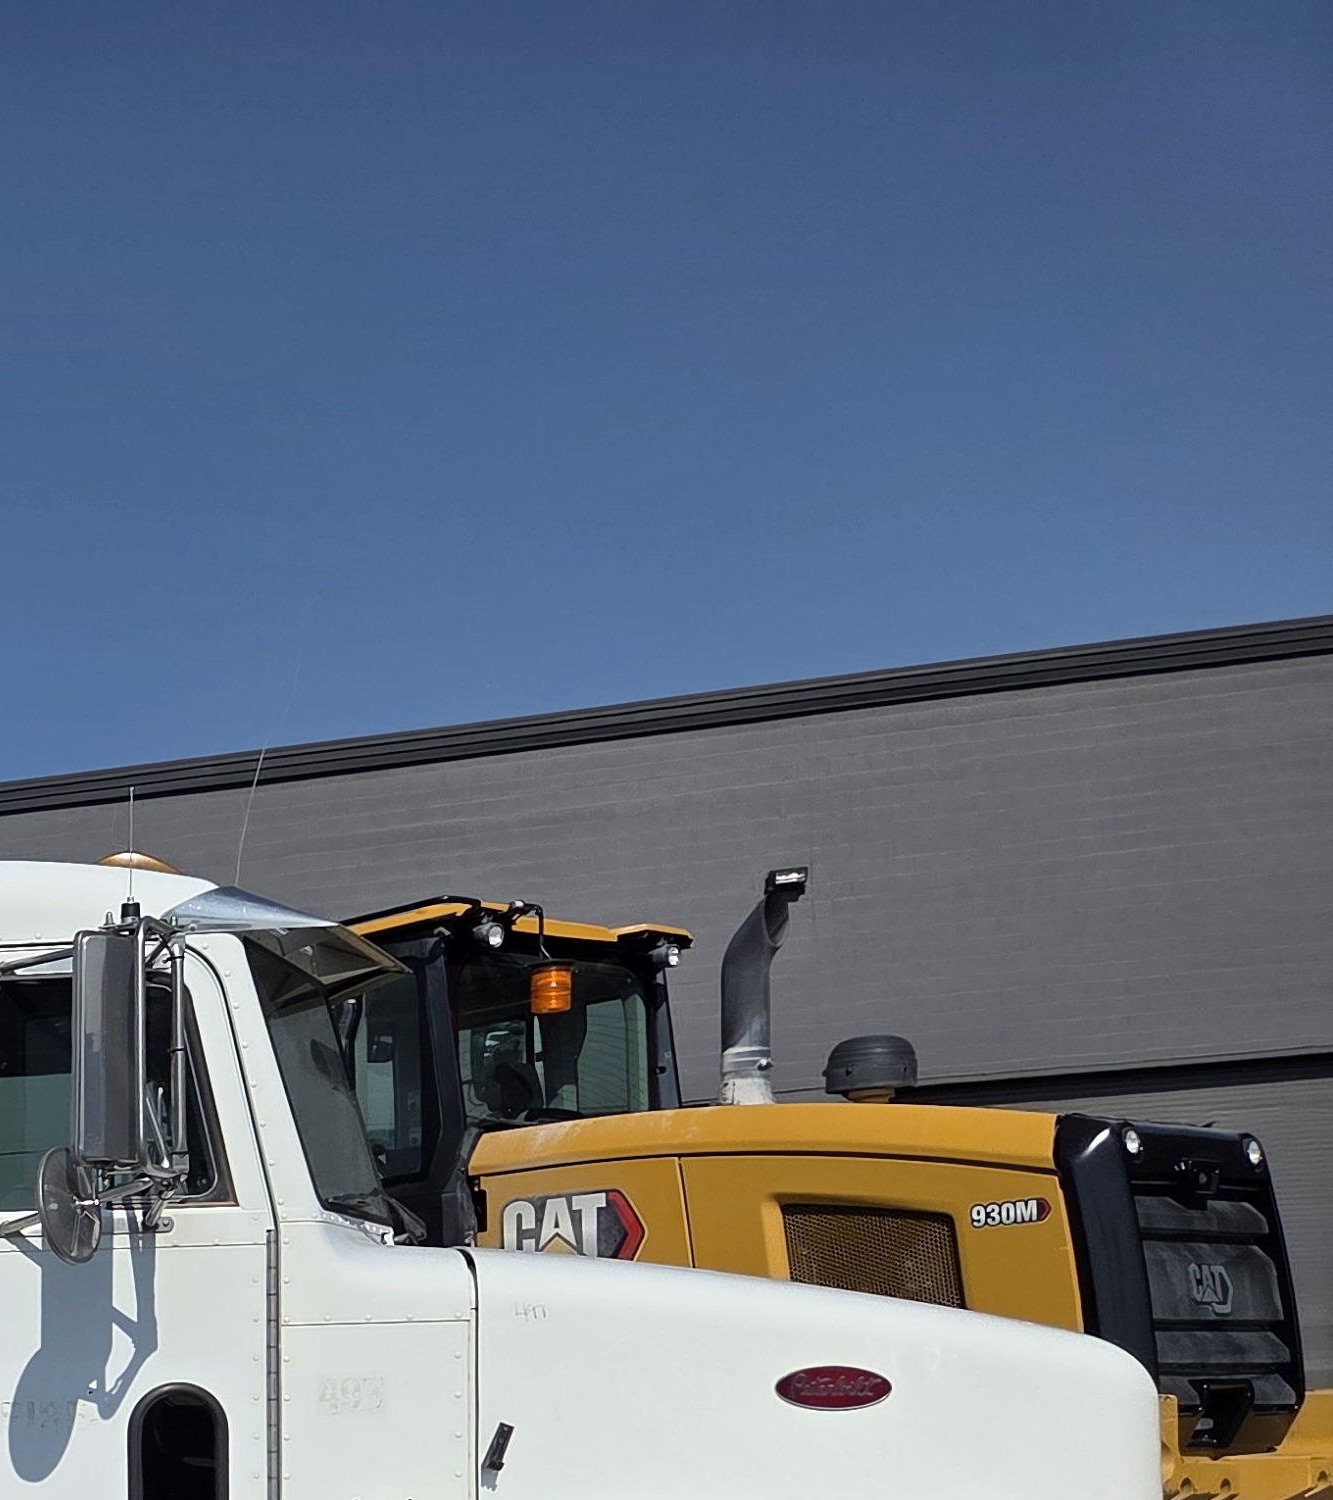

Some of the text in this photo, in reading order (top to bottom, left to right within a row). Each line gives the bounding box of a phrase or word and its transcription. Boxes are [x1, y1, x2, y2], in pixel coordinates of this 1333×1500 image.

[503, 1193, 607, 1257] CAT
[971, 1199, 1038, 1227] 930M
[1188, 1263, 1228, 1305] CAT
